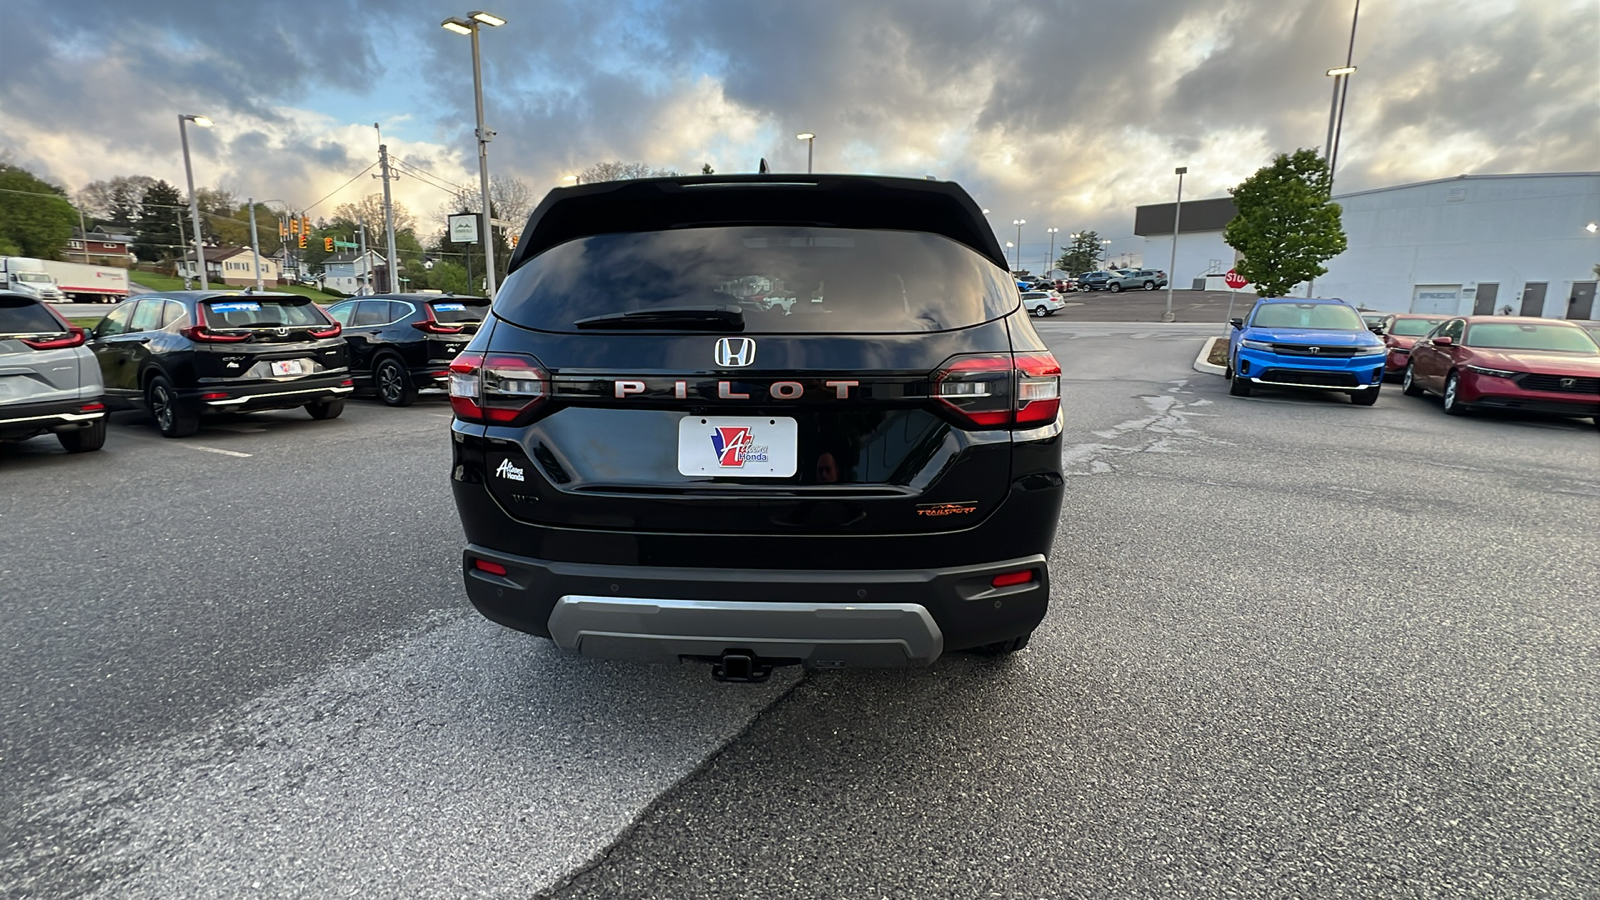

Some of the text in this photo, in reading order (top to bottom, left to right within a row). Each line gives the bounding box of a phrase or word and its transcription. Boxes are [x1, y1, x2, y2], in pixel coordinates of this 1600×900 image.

[614, 380, 860, 400] PILOT
[739, 453, 768, 461] Honda
[916, 506, 977, 517] TRAILSPORT
